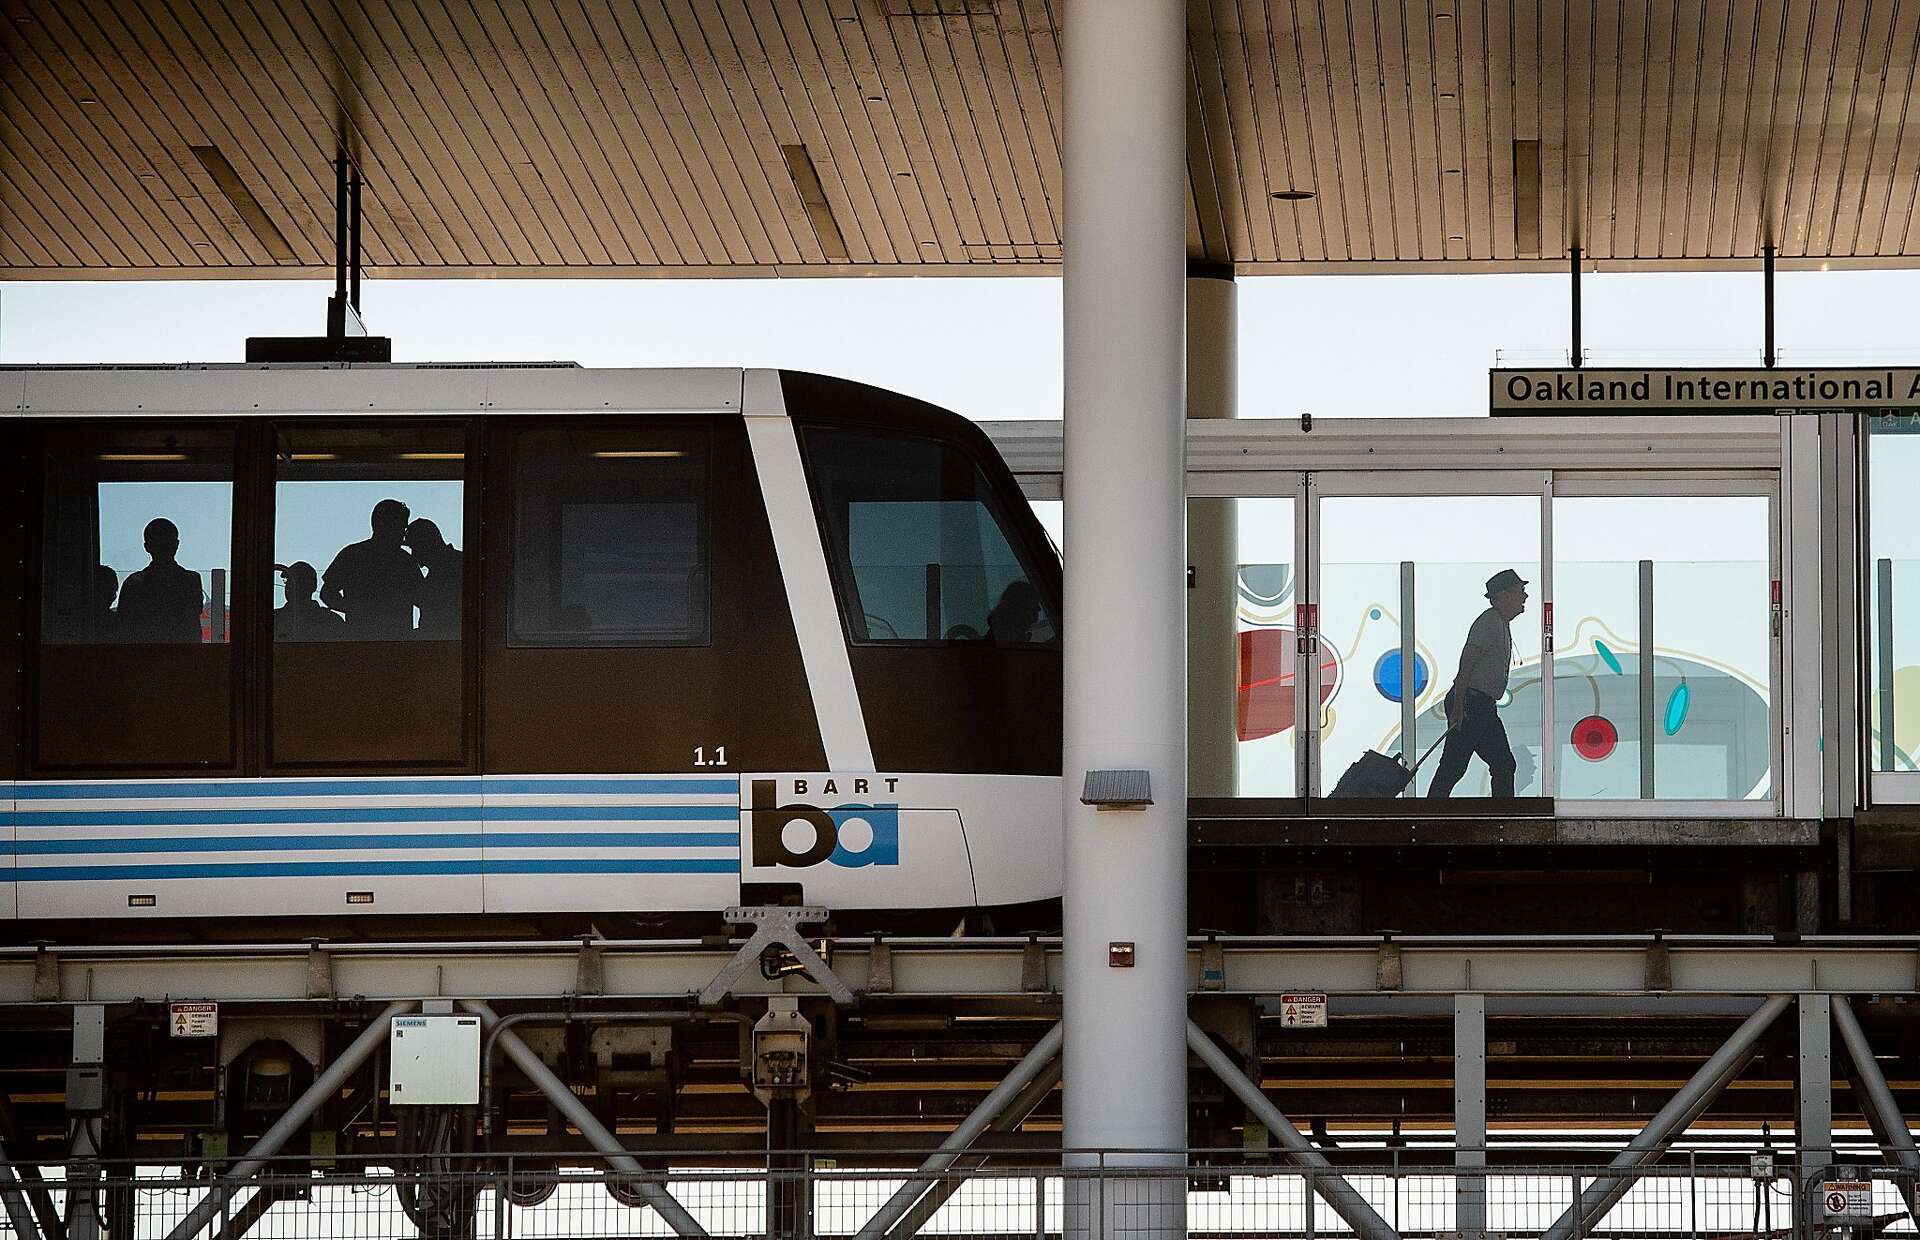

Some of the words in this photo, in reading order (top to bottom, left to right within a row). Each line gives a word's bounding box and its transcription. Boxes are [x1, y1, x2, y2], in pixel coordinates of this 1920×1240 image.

[1506, 372, 1650, 402] Oakland
[1665, 372, 1894, 401] International
[692, 745, 728, 766] 1.1
[794, 777, 899, 795] BART
[395, 1019, 427, 1027] SIEMENS
